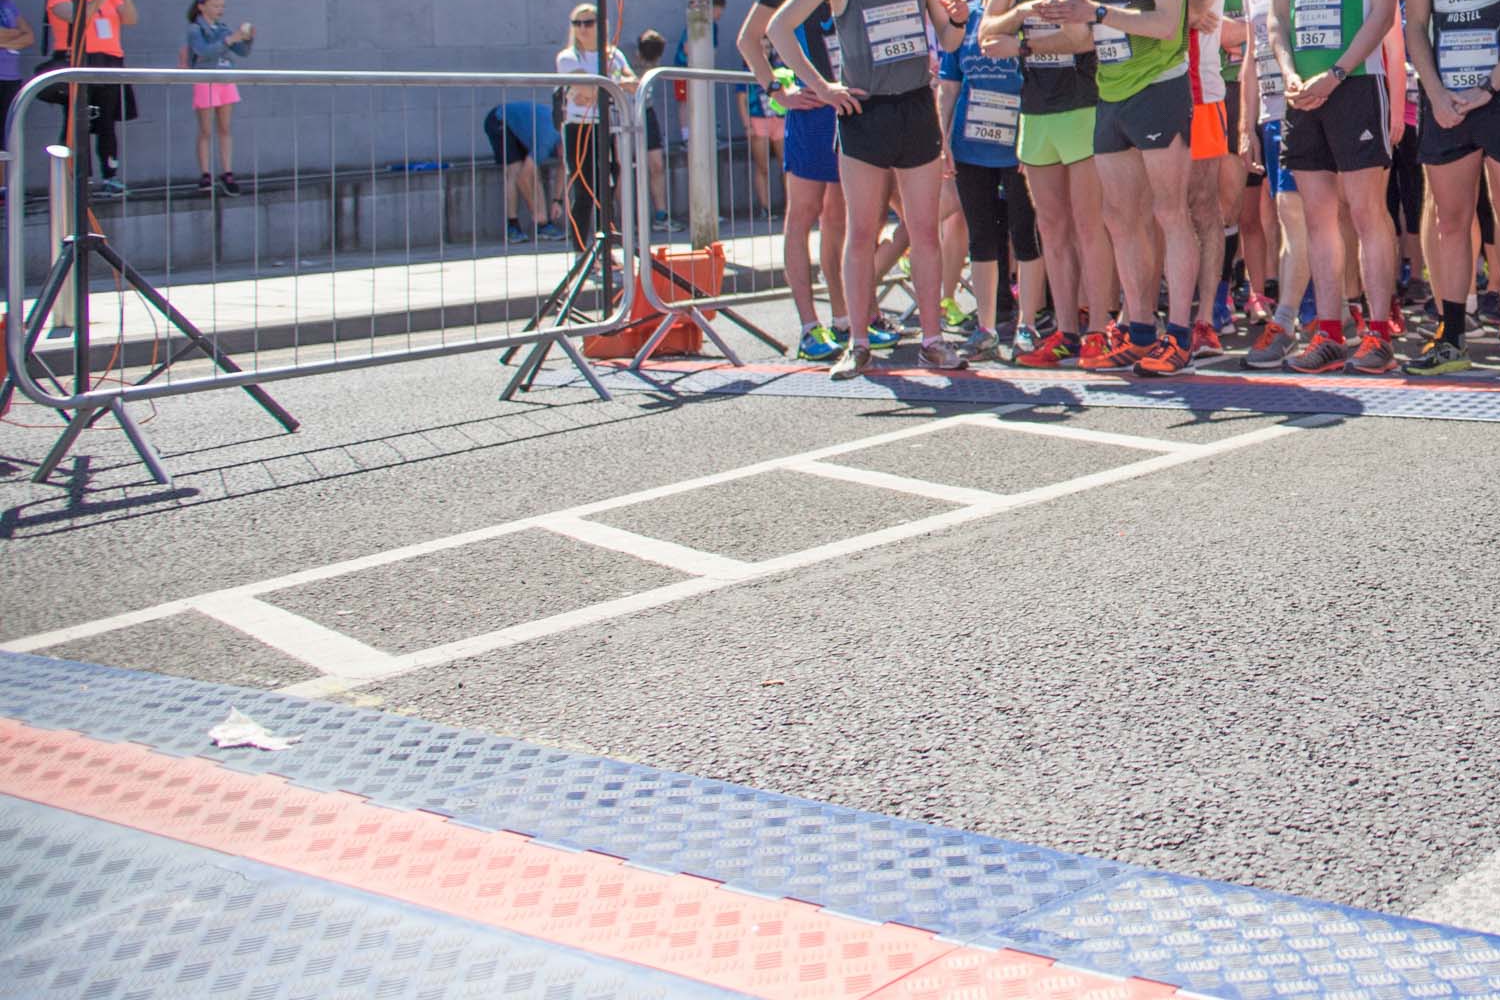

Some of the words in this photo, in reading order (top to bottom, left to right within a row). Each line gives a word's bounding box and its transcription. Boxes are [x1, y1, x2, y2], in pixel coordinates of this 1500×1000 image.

[1447, 10, 1481, 23] HOSTEL
[884, 41, 915, 56] 6833
[975, 126, 1002, 140] 7048
